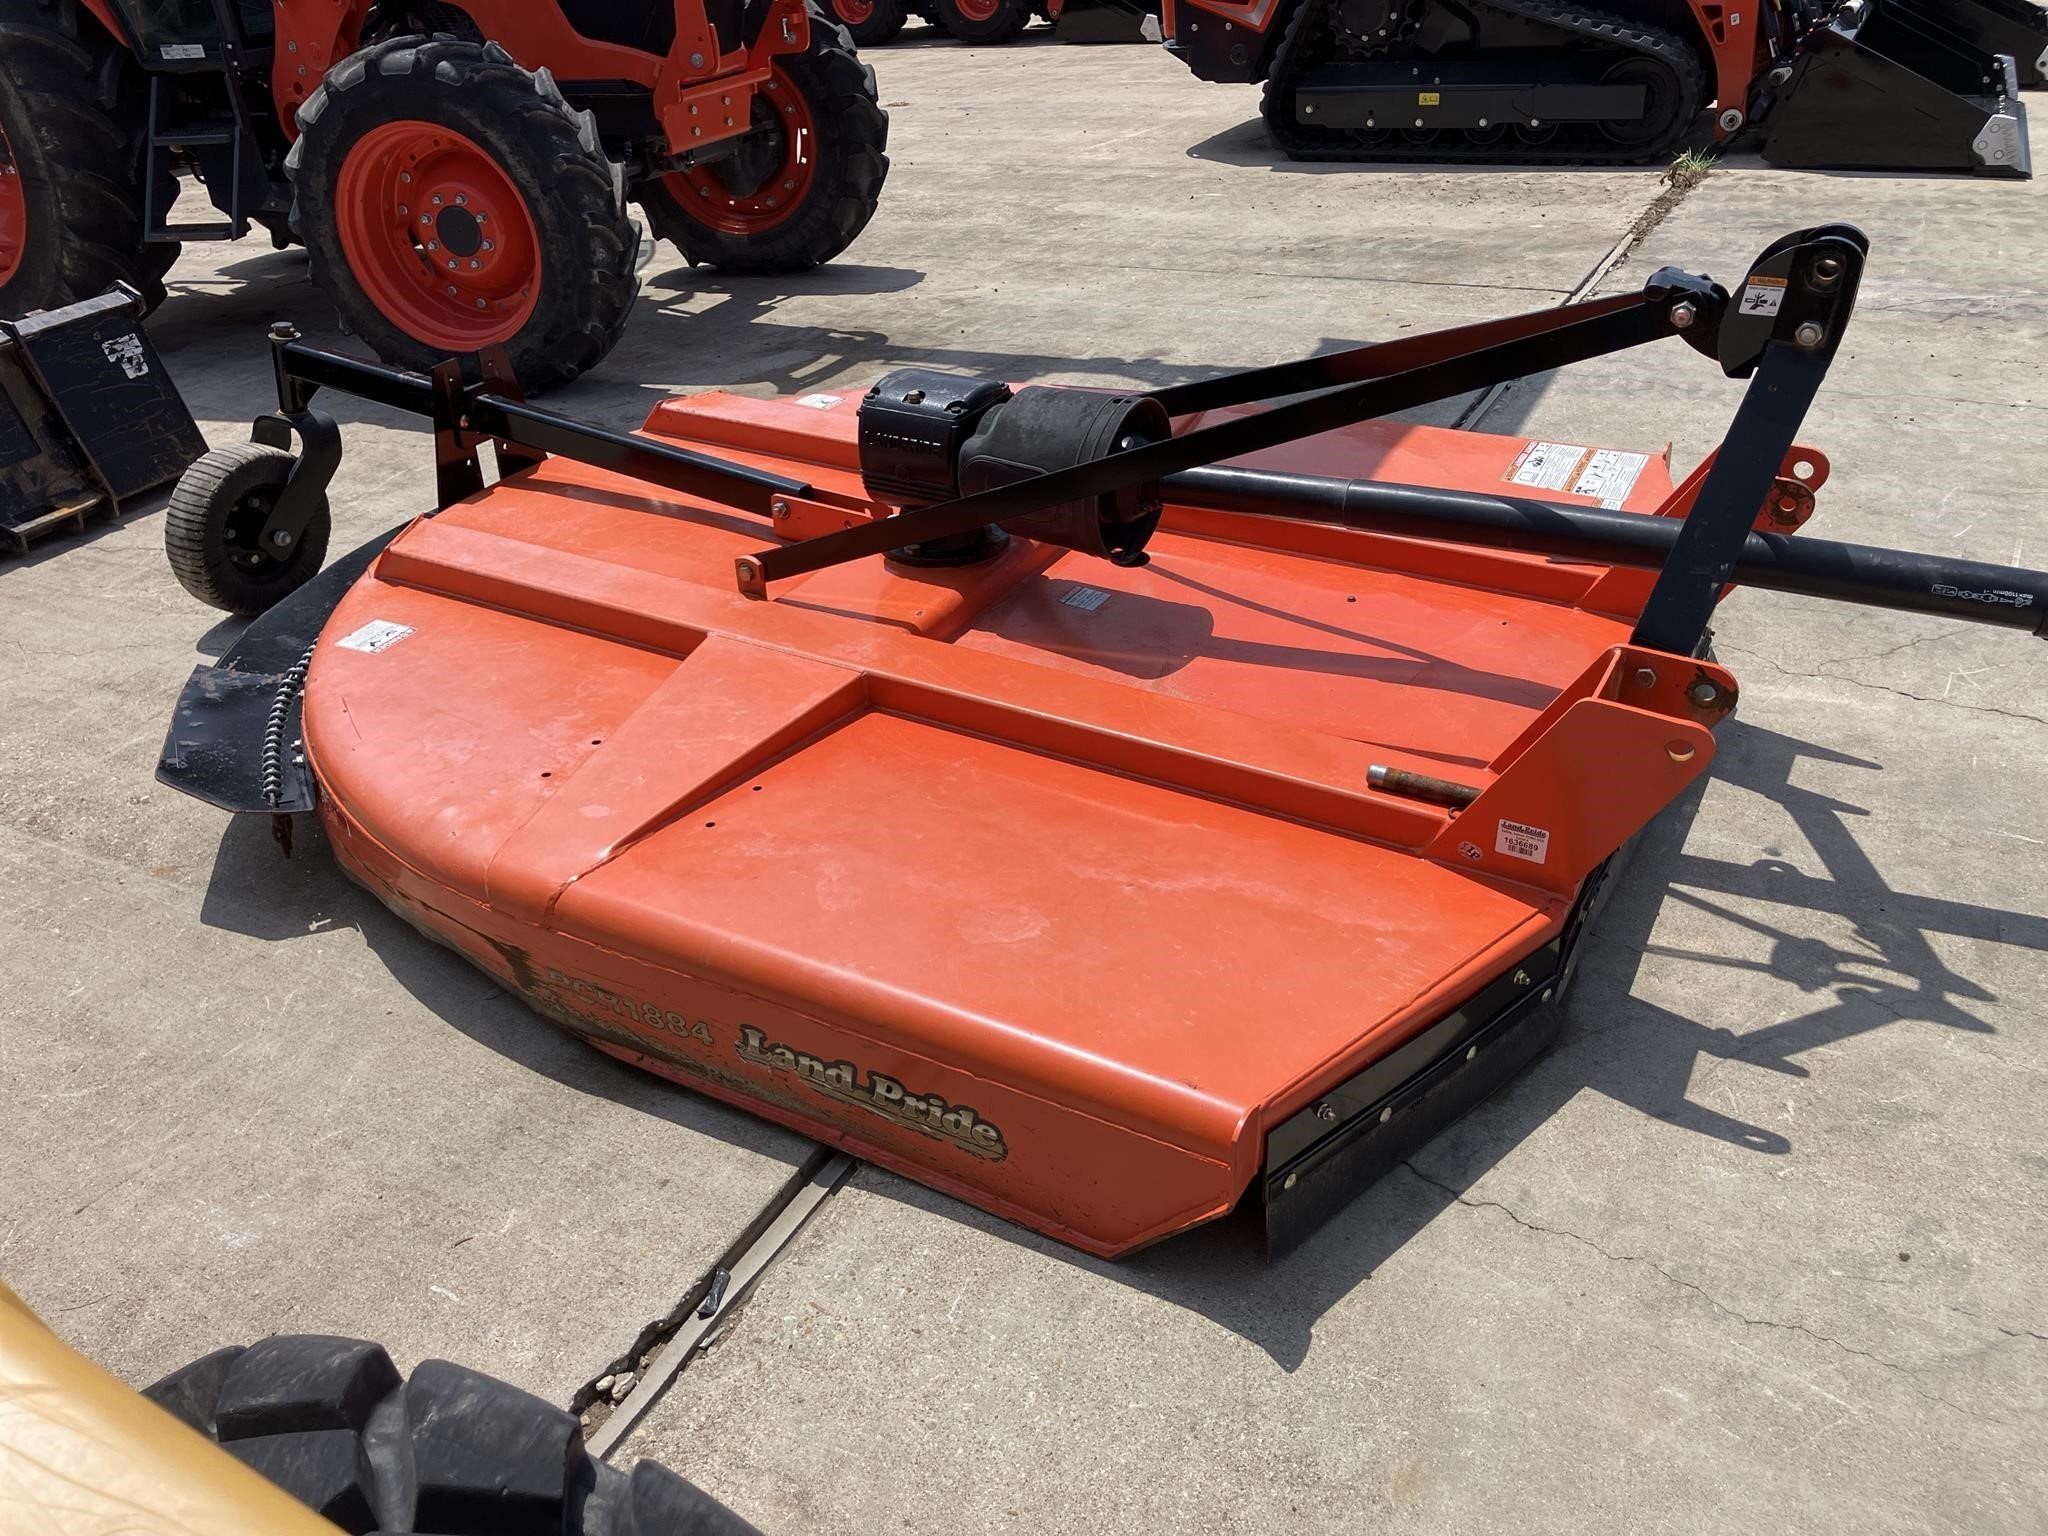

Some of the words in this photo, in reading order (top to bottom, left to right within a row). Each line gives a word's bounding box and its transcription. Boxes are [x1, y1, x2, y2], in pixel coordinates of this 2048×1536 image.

[1501, 821, 1524, 833] Land
[1525, 826, 1547, 838] Pride
[738, 1025, 856, 1093] Land
[870, 1073, 1001, 1147] Pride
